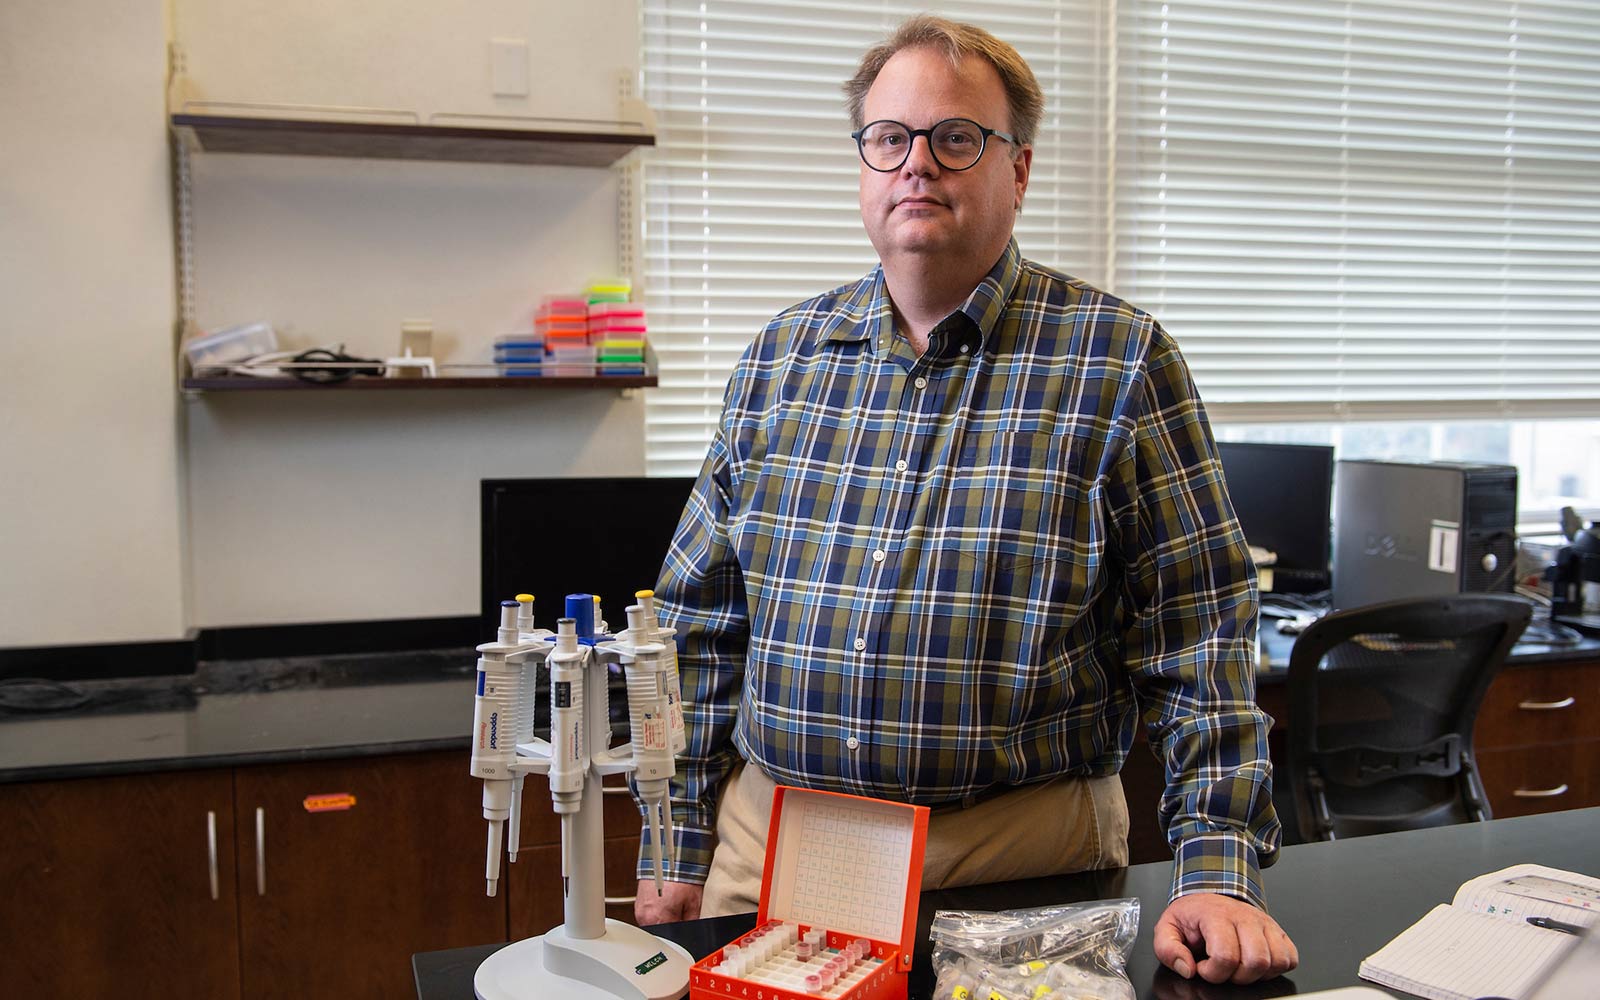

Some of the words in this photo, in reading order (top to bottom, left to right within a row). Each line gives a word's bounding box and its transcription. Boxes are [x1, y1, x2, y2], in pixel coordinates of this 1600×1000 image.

[490, 712, 498, 750] eppendorf
[710, 979, 715, 988] 2
[726, 983, 731, 992] 3
[742, 987, 748, 996] 4
